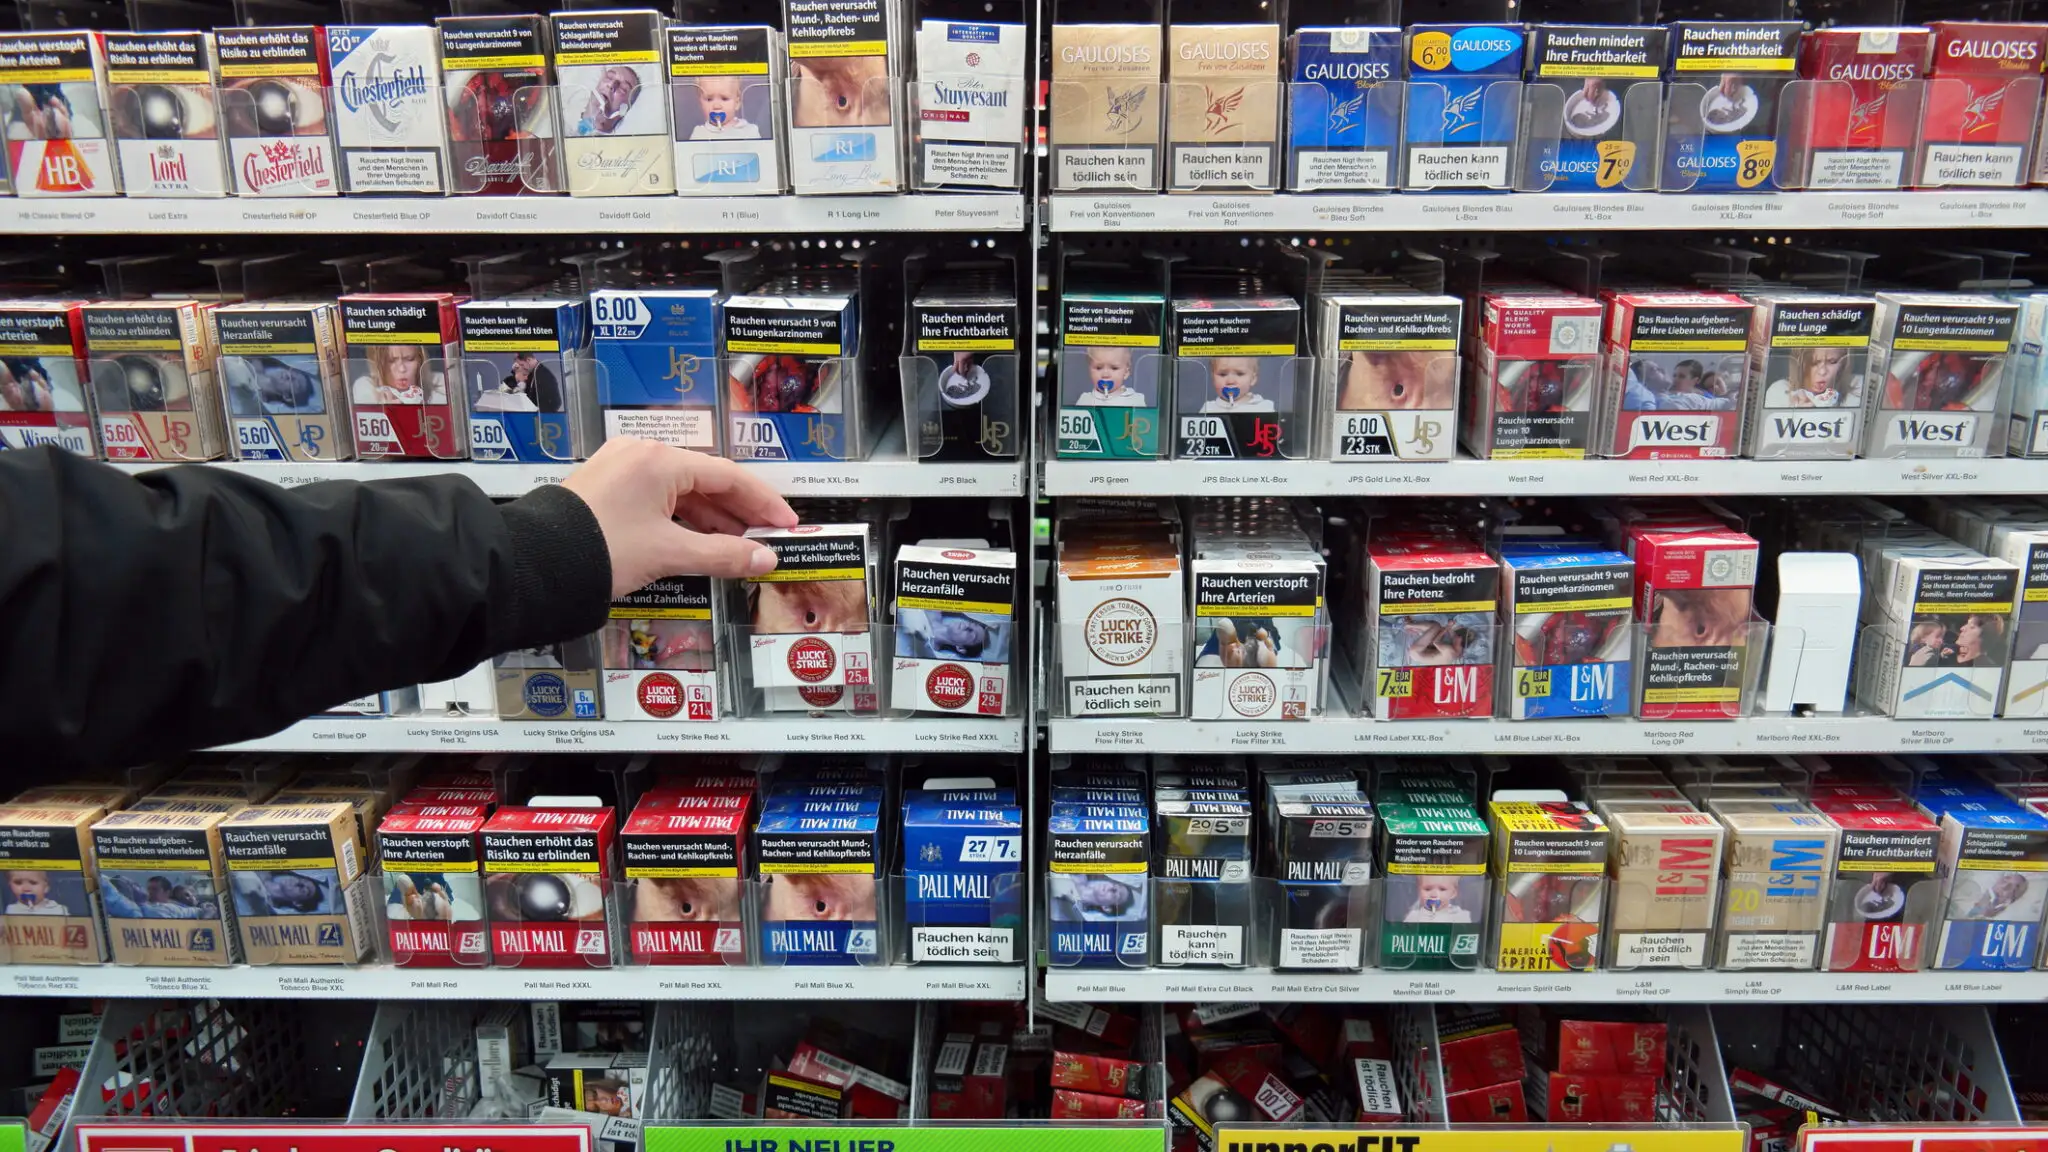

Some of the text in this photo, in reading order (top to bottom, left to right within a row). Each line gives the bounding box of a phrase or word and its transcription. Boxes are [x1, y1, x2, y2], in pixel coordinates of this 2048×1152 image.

[444, 30, 532, 40] Rauchen verursacht 9 von
[1684, 28, 1780, 41] Rauchen mindert
[108, 40, 195, 52] Rauchen erhöht das
[331, 37, 351, 52] 20
[446, 40, 521, 50] 10 Lungenkarzinomen
[1453, 39, 1511, 51] GAULOISES
[1548, 34, 1644, 48] Rauchen mindert
[1062, 46, 1150, 64] GAULOISES
[1180, 41, 1270, 61] GAULOISES
[1682, 43, 1783, 57] Ihre Fruchtbarkeit
[1947, 40, 2036, 59] GAULOISES
[110, 53, 193, 65] Risiko zu erblinden
[1546, 50, 1646, 64] Ihre Fruchtbarkeit
[1305, 63, 1389, 80] GAULOISES
[1830, 64, 1915, 80] GAULOISES
[340, 66, 427, 113] Chesterfield
[934, 83, 1007, 109] Stuyvesant
[923, 112, 966, 120] ORIGINAL
[45, 156, 80, 184] HB
[150, 153, 186, 182] Lord
[244, 145, 324, 193] Chesterfield
[1540, 160, 1597, 173] GAULOISES
[149, 212, 187, 220] Lord Extra
[476, 212, 537, 220] Davidoff Classic
[957, 209, 998, 218] Stuyvesant
[347, 306, 426, 318] Rauchen schädigt
[596, 298, 636, 321] 6.00
[221, 318, 307, 330] Rauchen verursacht
[348, 318, 396, 331] Ihre Lunge
[730, 316, 766, 326] Rauchen
[768, 317, 810, 327] verursacht
[813, 318, 818, 327] 9
[922, 313, 1005, 324] Rauchen mindert
[223, 329, 272, 340] Herzanfälle
[731, 328, 822, 339] 10 Lungenkarzinomen
[922, 326, 1008, 338] Ihre Fruchtbarkeit
[736, 420, 773, 443] 7.00
[1060, 417, 1091, 435] 5.60
[1187, 420, 1217, 437] 6.00
[1347, 418, 1378, 434] 6.00
[1641, 420, 1711, 442] West
[1774, 417, 1844, 439] West
[1899, 420, 1965, 441] West
[240, 426, 269, 444] 5.60
[473, 425, 502, 443] 5.60
[957, 476, 977, 484] Black
[1089, 476, 1129, 484] JPS Green
[1348, 475, 1430, 483] JPS Gold Line XL-Box
[1508, 475, 1544, 483] West Red
[903, 568, 1010, 585] Rauchen verursacht
[1385, 573, 1475, 585] Rauchen bedroht
[902, 582, 964, 596] Herzanfälle
[1384, 588, 1443, 599] Ihre Potenz
[1101, 620, 1141, 631] LUCKY
[1099, 632, 1143, 644] STRIKE
[797, 650, 826, 659] LUCKY
[796, 659, 827, 668] STRIKE
[936, 677, 965, 686] LUCKY
[1434, 666, 1477, 704] L&M
[1570, 665, 1613, 702] L&M
[646, 686, 675, 695] LUCKY
[935, 686, 965, 695] STRIKE
[1074, 684, 1171, 696] Rauchen kann
[645, 695, 677, 704] STRIKE
[1085, 698, 1161, 710] tödlich sein
[681, 733, 702, 741] Strike
[1354, 734, 1371, 742] L&M
[1389, 734, 1409, 742] Label
[226, 831, 327, 844] Rauchen verursacht
[486, 836, 593, 848] Rauchen erhöht das
[1846, 835, 1931, 846] Rauchen mindert
[229, 845, 287, 856] Herzanfälle
[969, 840, 1010, 857] 27 7
[1844, 848, 1932, 858] Ihre Fruchtbarkeit
[487, 850, 590, 861] Risiko zu erblinden
[1166, 859, 1218, 878] PALL MALL
[919, 875, 990, 899] PALL MALL
[500, 931, 566, 952] PALL MALL
[637, 931, 704, 952] PALL MALL
[772, 930, 837, 951] PALL MALL
[918, 933, 1008, 944] Rauchen kann
[1392, 935, 1445, 953] PALL MALL
[1869, 924, 1912, 959] L&M
[1982, 922, 2029, 958] L&M
[927, 946, 999, 957] tödlich sein
[1503, 946, 1553, 955] AMERICAN
[1501, 956, 1553, 969] SPIRIT
[1534, 985, 1553, 993] Spirit
